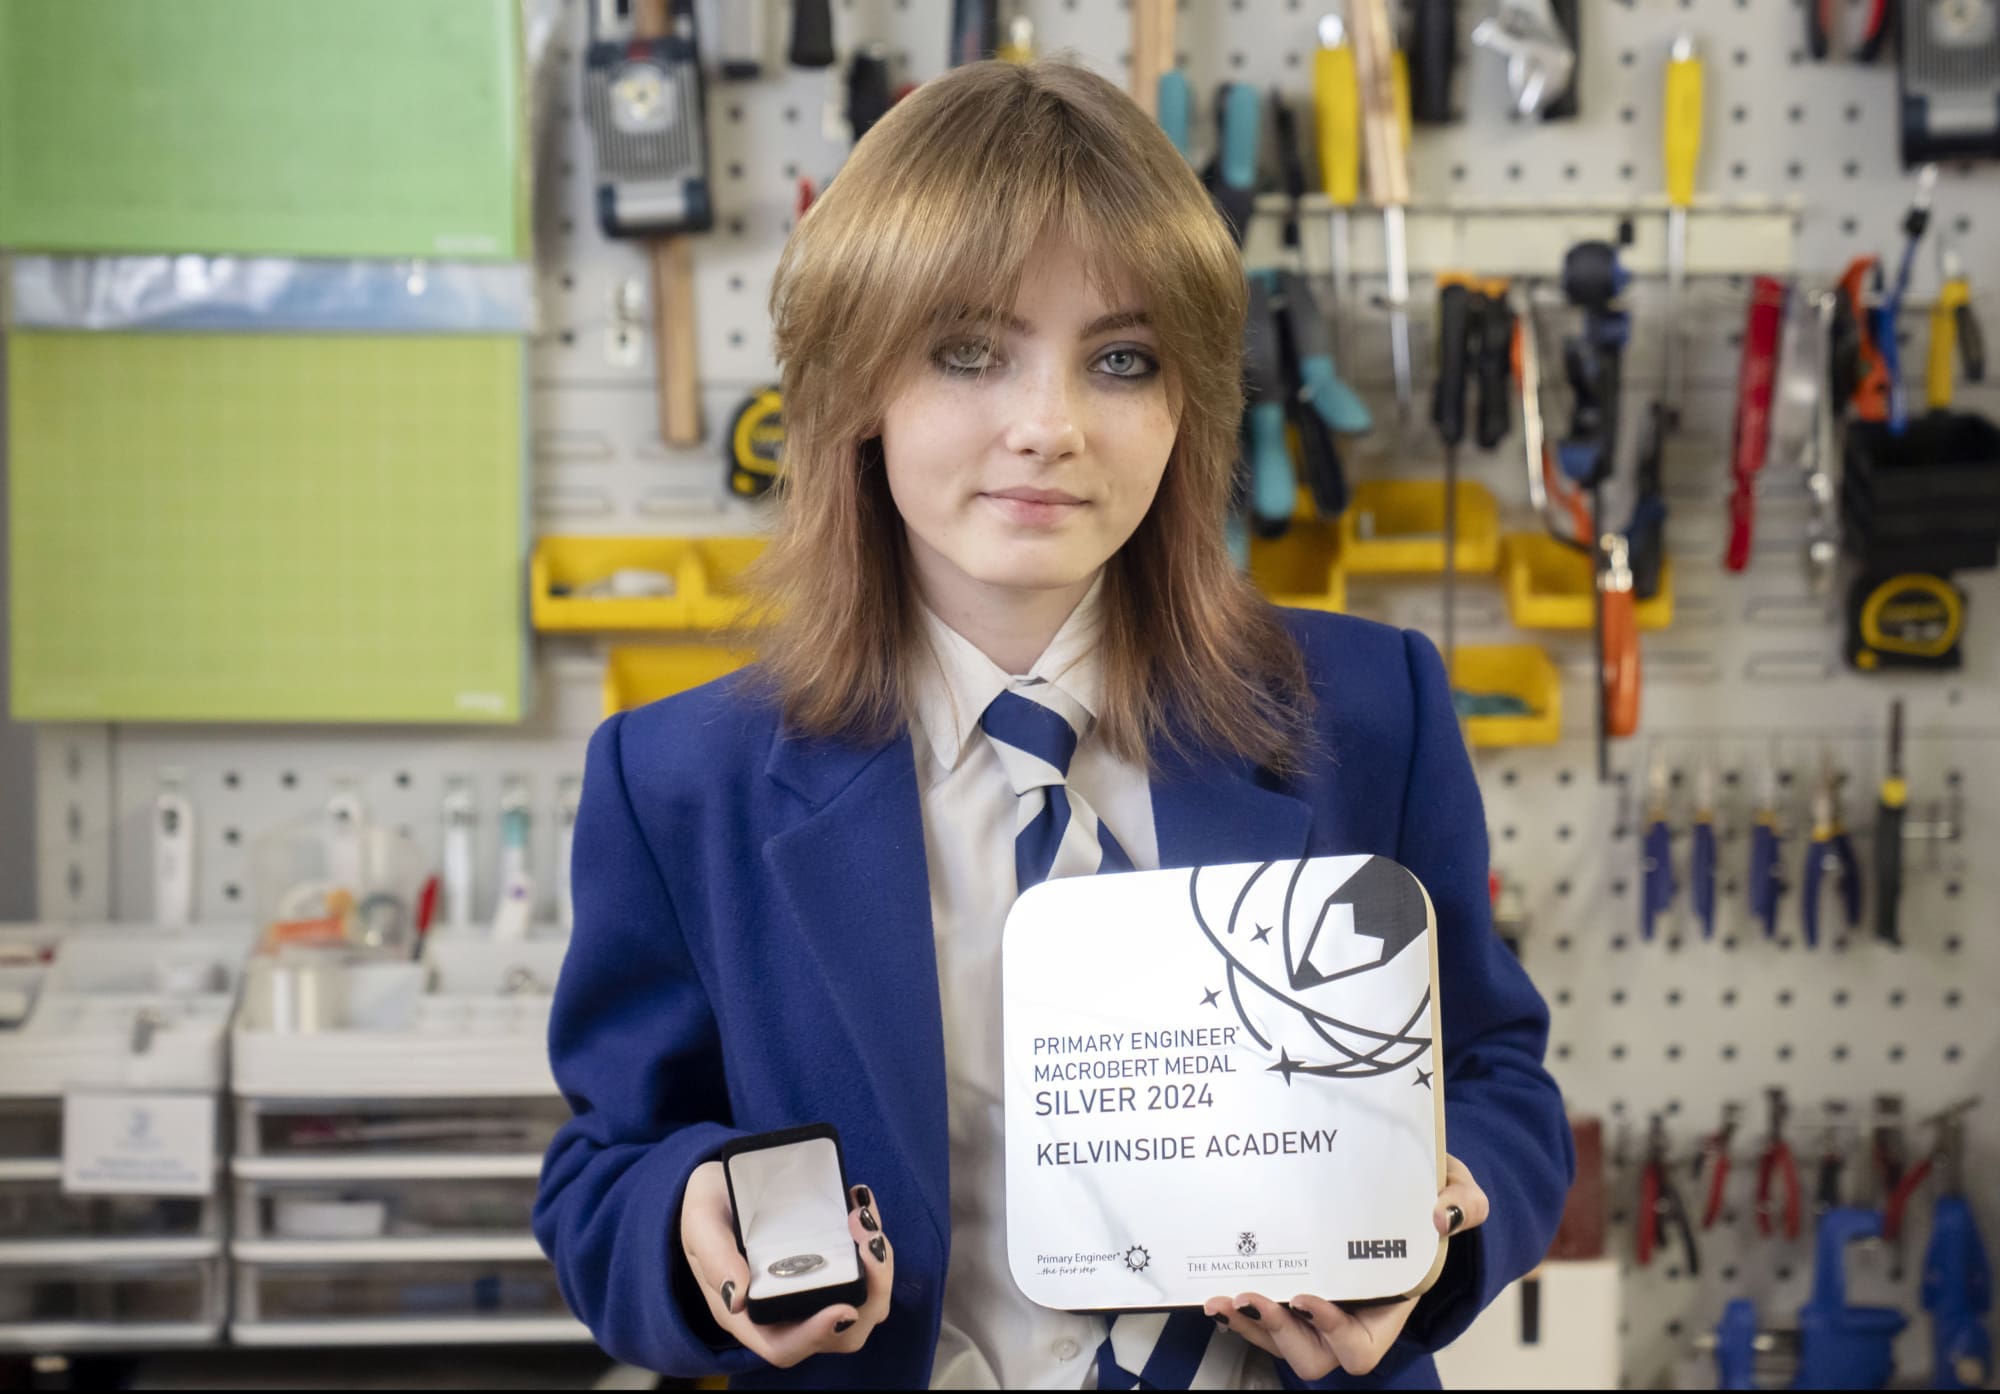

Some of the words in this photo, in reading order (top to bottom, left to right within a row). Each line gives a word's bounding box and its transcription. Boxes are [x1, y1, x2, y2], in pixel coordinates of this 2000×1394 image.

[1033, 1033, 1124, 1055] PRIMARY
[1131, 1027, 1236, 1050] ENGINEER
[1034, 1058, 1160, 1083] MACROBERT
[1165, 1053, 1237, 1076] MEDAL
[1035, 1086, 1136, 1116] SILVER
[1147, 1082, 1214, 1111] 2024
[1036, 1136, 1196, 1166] KELVINSIDE
[1205, 1129, 1338, 1158] ACADEMY
[1037, 1254, 1073, 1265] Primary
[1347, 1239, 1407, 1260] WEIR
